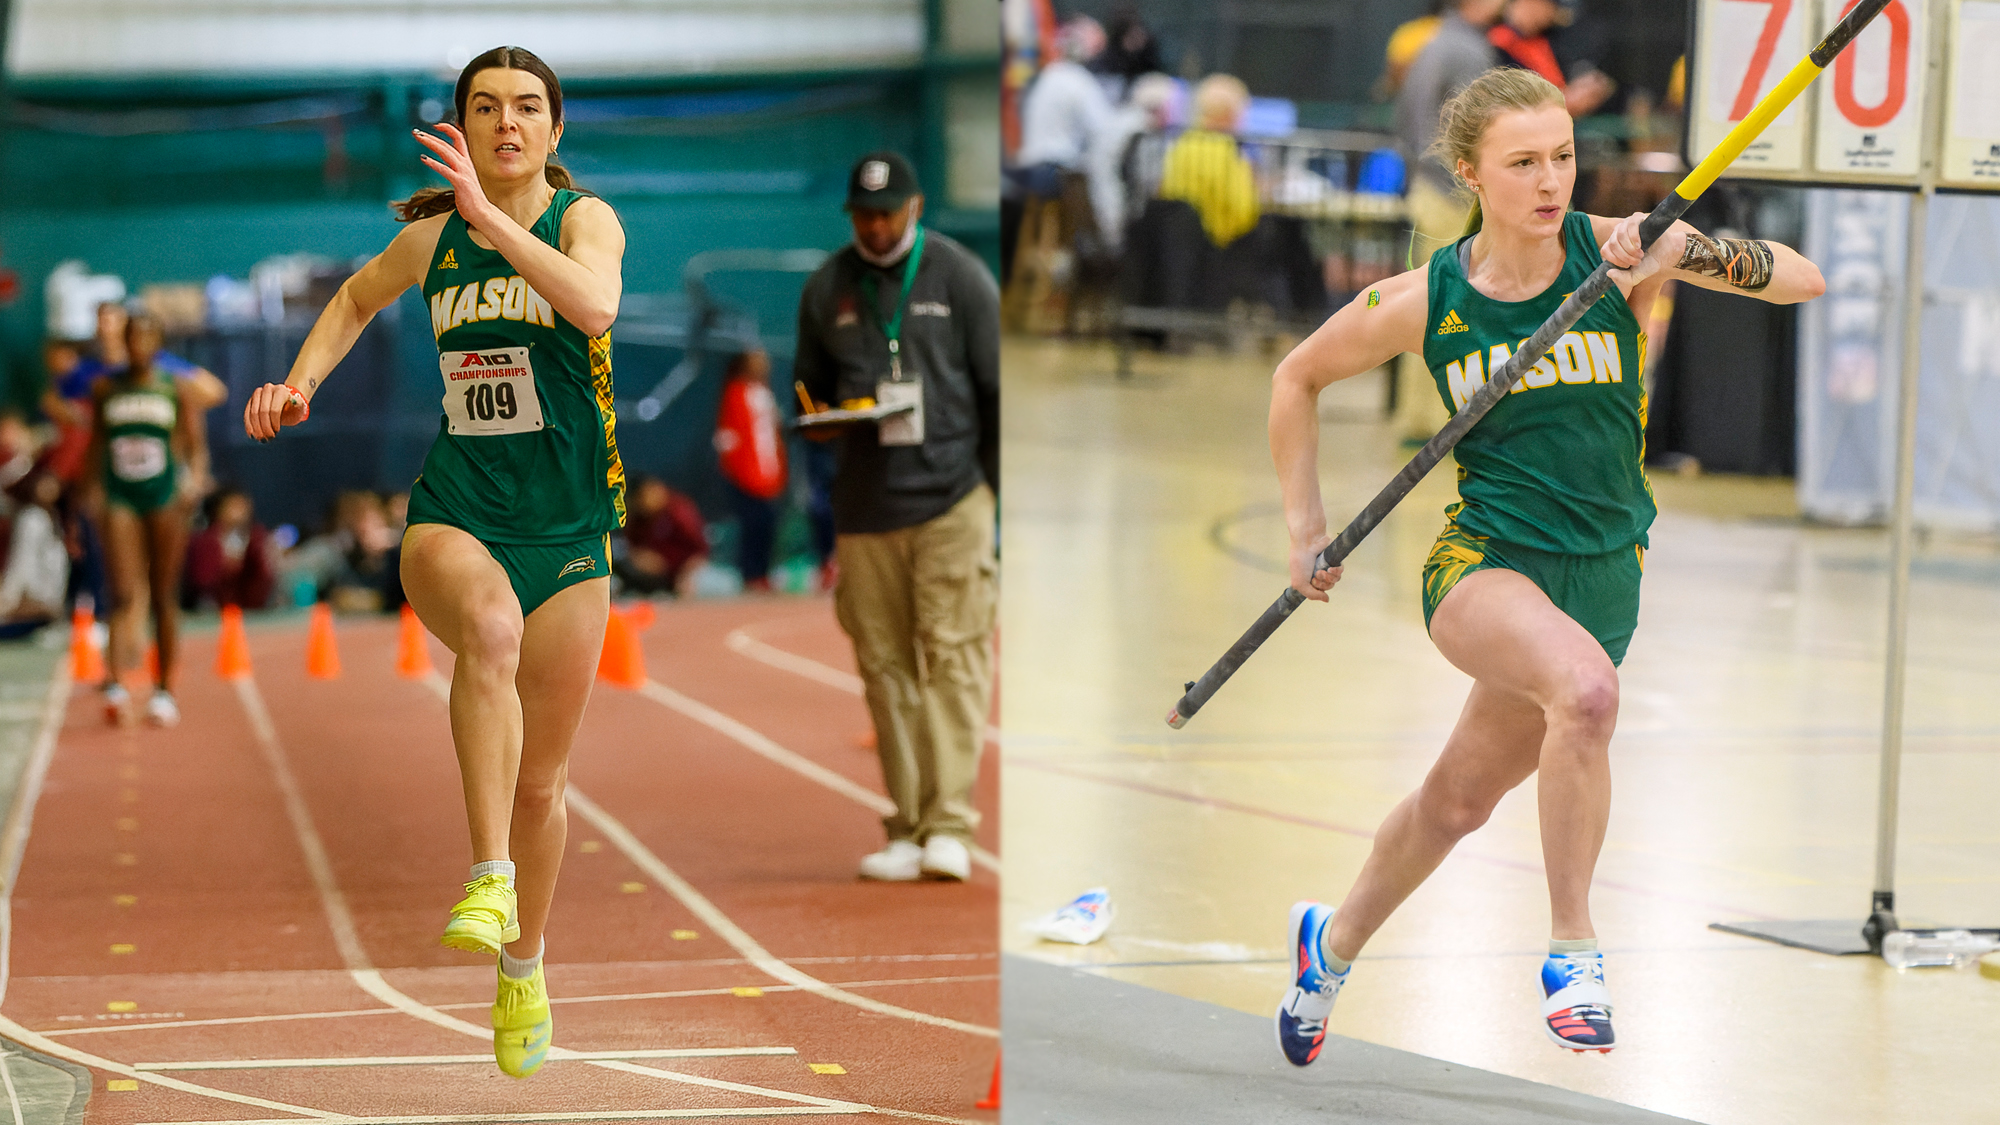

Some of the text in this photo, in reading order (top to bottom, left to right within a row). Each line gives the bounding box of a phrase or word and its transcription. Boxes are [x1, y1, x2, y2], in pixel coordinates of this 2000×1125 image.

[431, 275, 555, 342] MASON
[1437, 323, 1469, 335] adidas
[460, 353, 513, 367] A10
[450, 367, 527, 381] CHAMPIONSHIPS
[463, 382, 518, 421] 109
